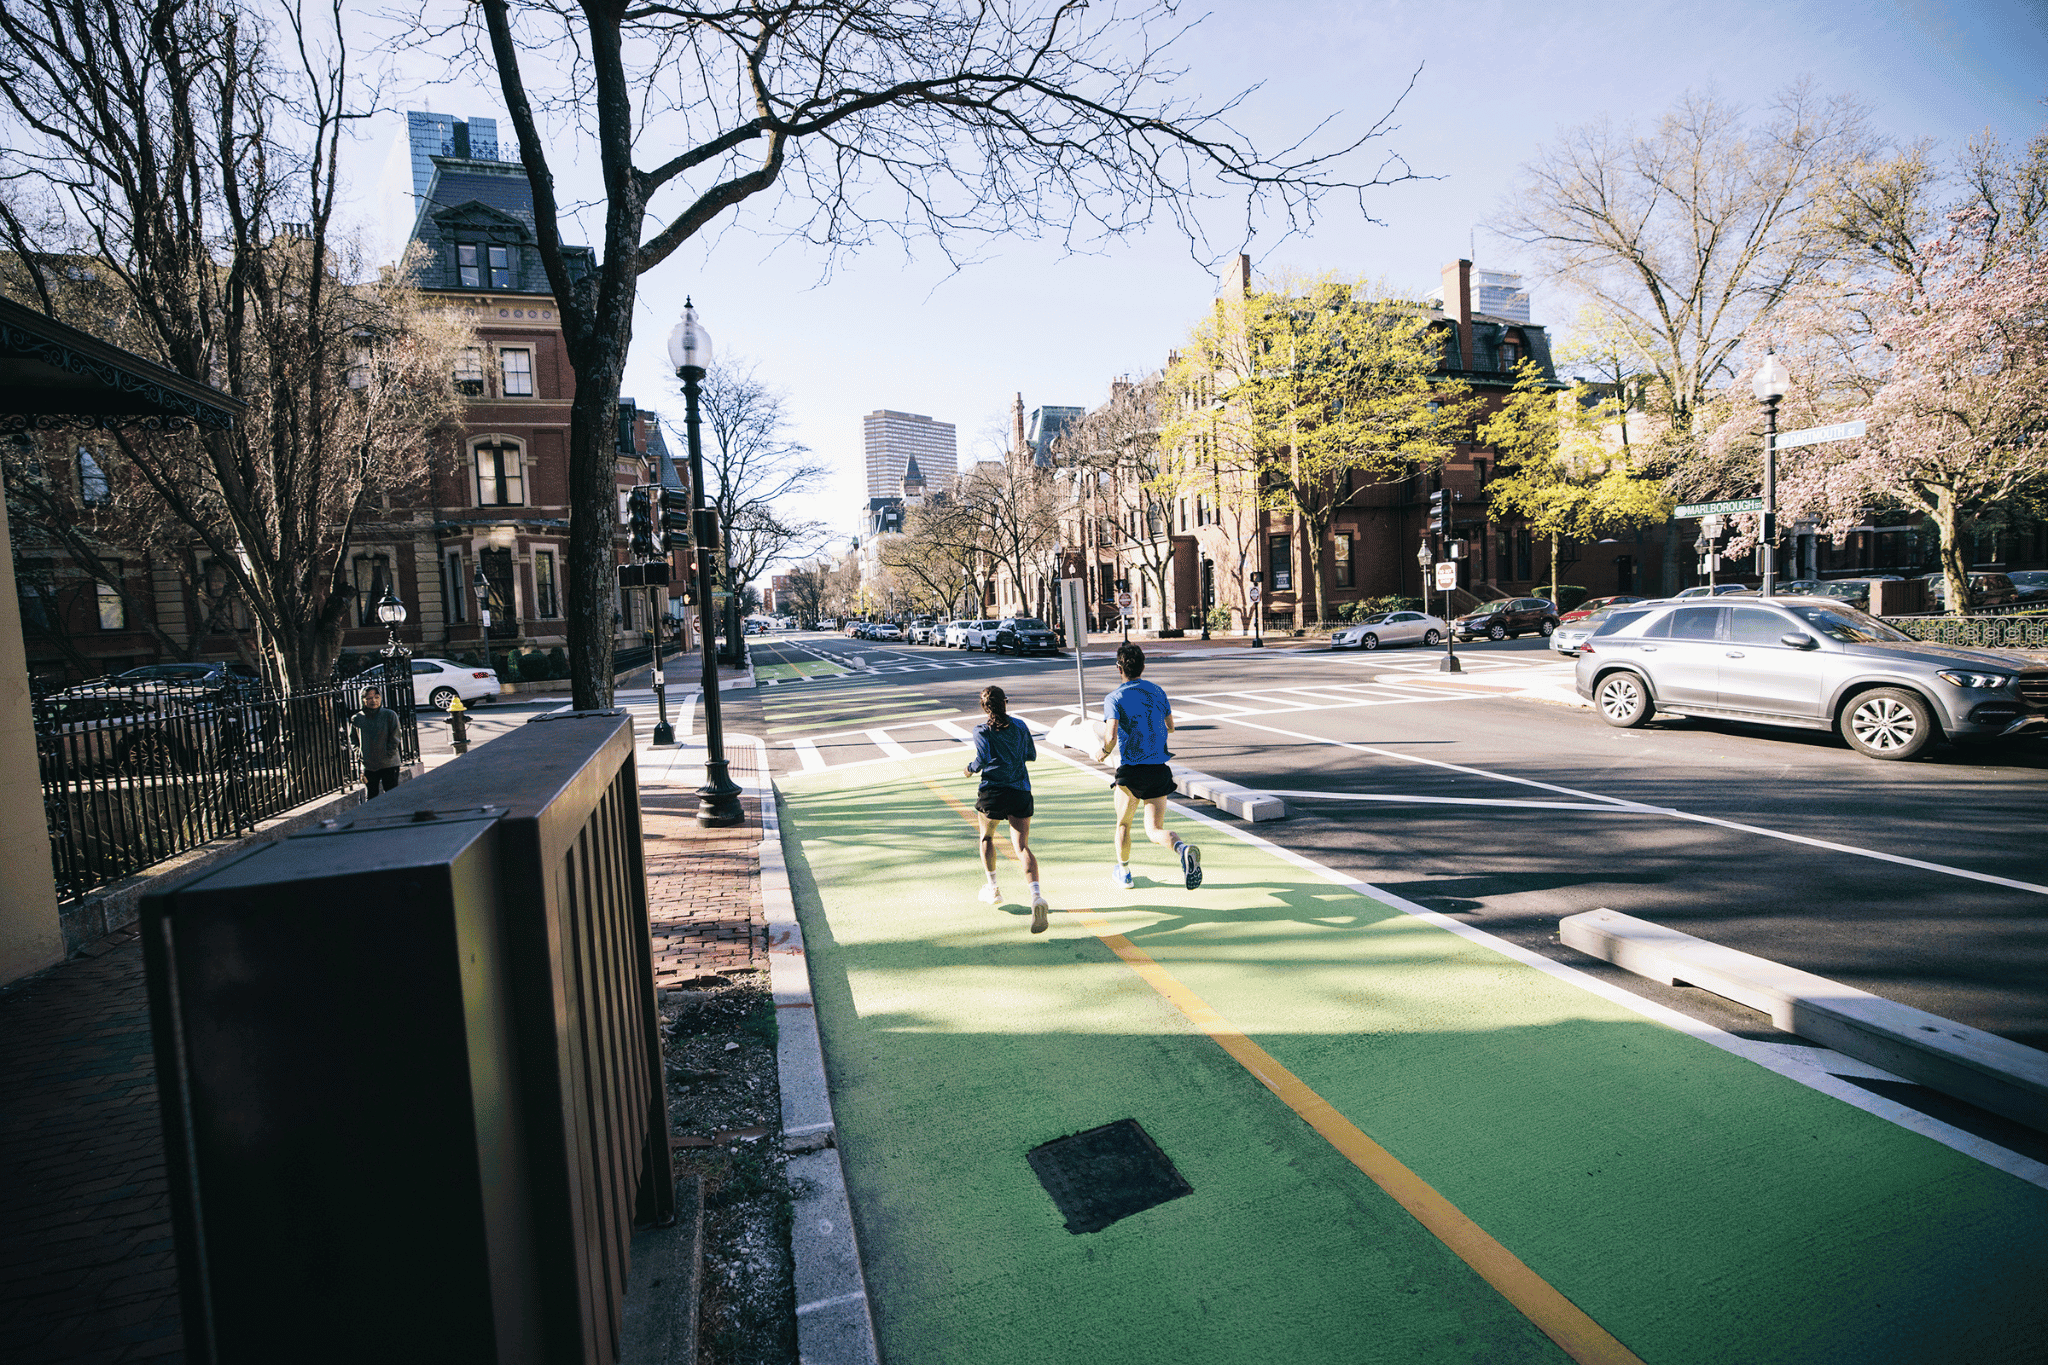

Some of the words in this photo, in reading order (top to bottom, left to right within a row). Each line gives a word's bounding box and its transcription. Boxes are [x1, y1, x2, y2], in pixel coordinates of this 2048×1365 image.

[1790, 426, 1844, 444] DARTMOUTH
[1848, 427, 1856, 436] ST
[1687, 501, 1754, 515] MARLBOROUGH
[1755, 502, 1762, 510] ST
